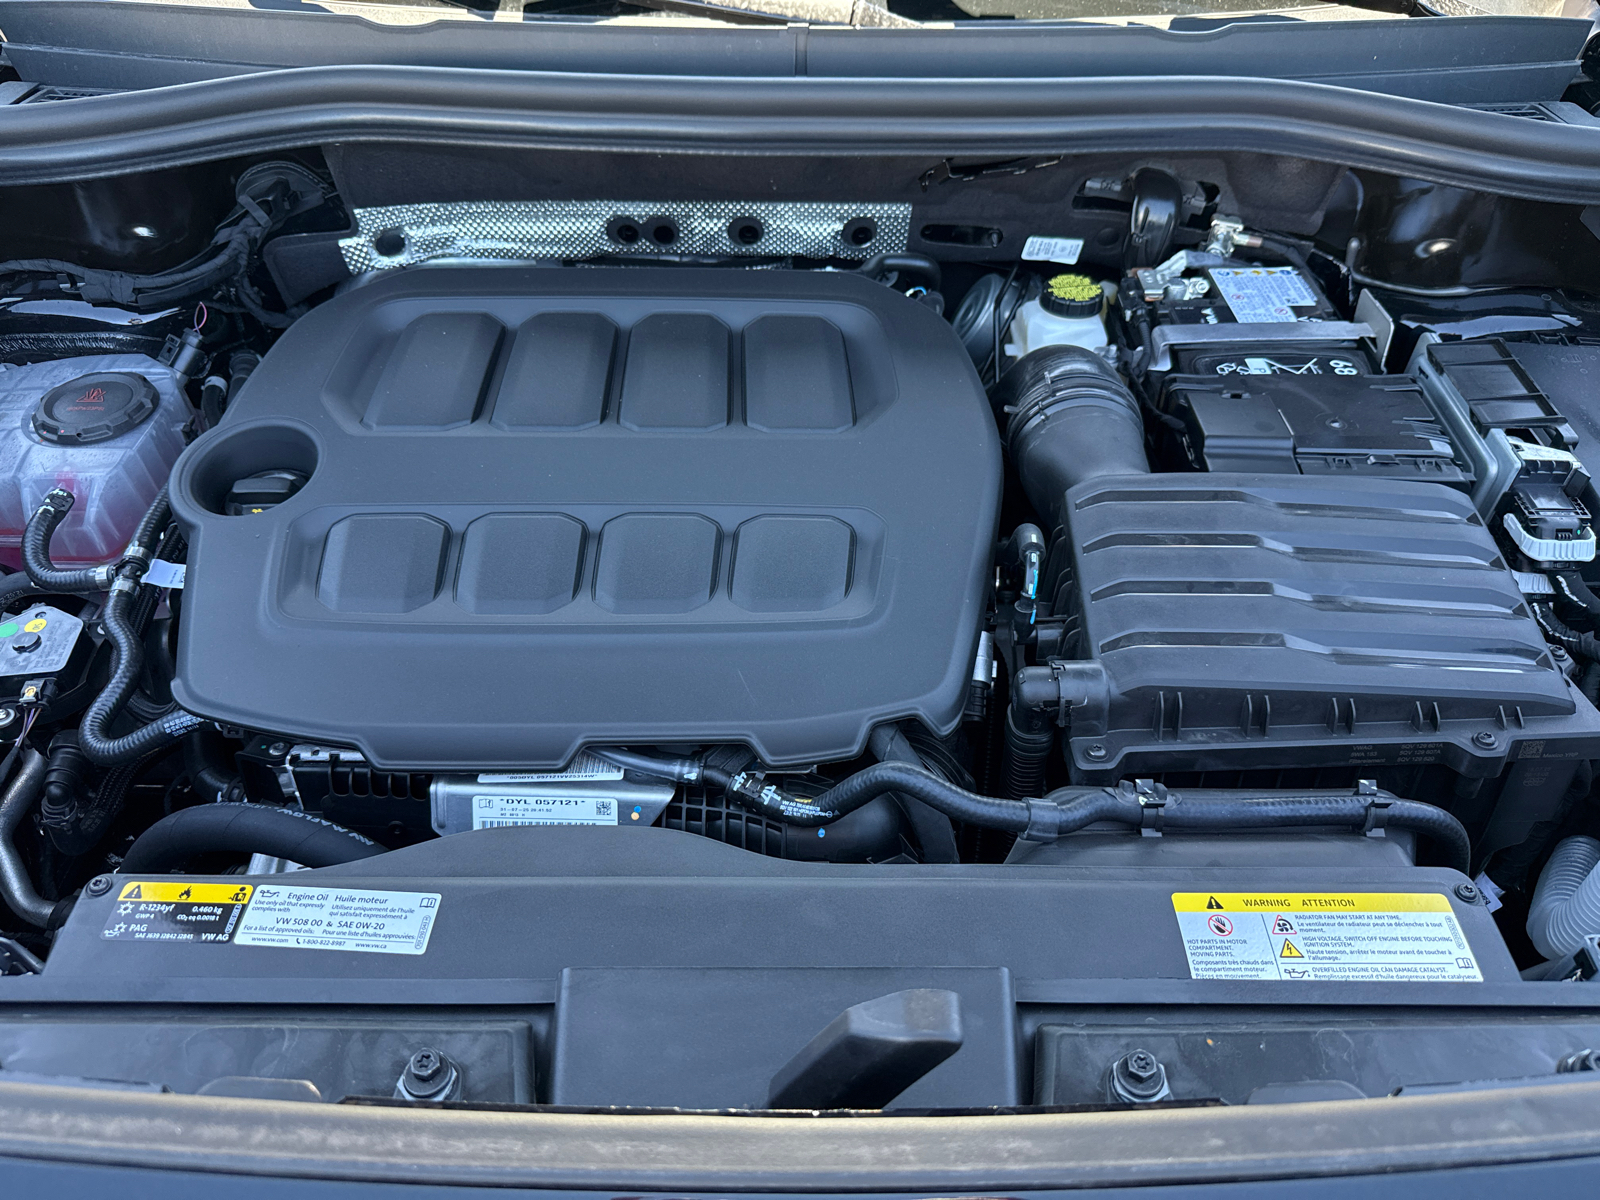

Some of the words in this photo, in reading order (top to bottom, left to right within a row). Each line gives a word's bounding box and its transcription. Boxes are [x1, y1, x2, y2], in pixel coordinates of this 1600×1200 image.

[288, 892, 315, 901] Engine
[1242, 899, 1291, 907] WARNING
[139, 904, 176, 914] R-1234yf
[214, 906, 223, 914] kg
[129, 924, 148, 932] PAG
[355, 922, 385, 930] 0W-20
